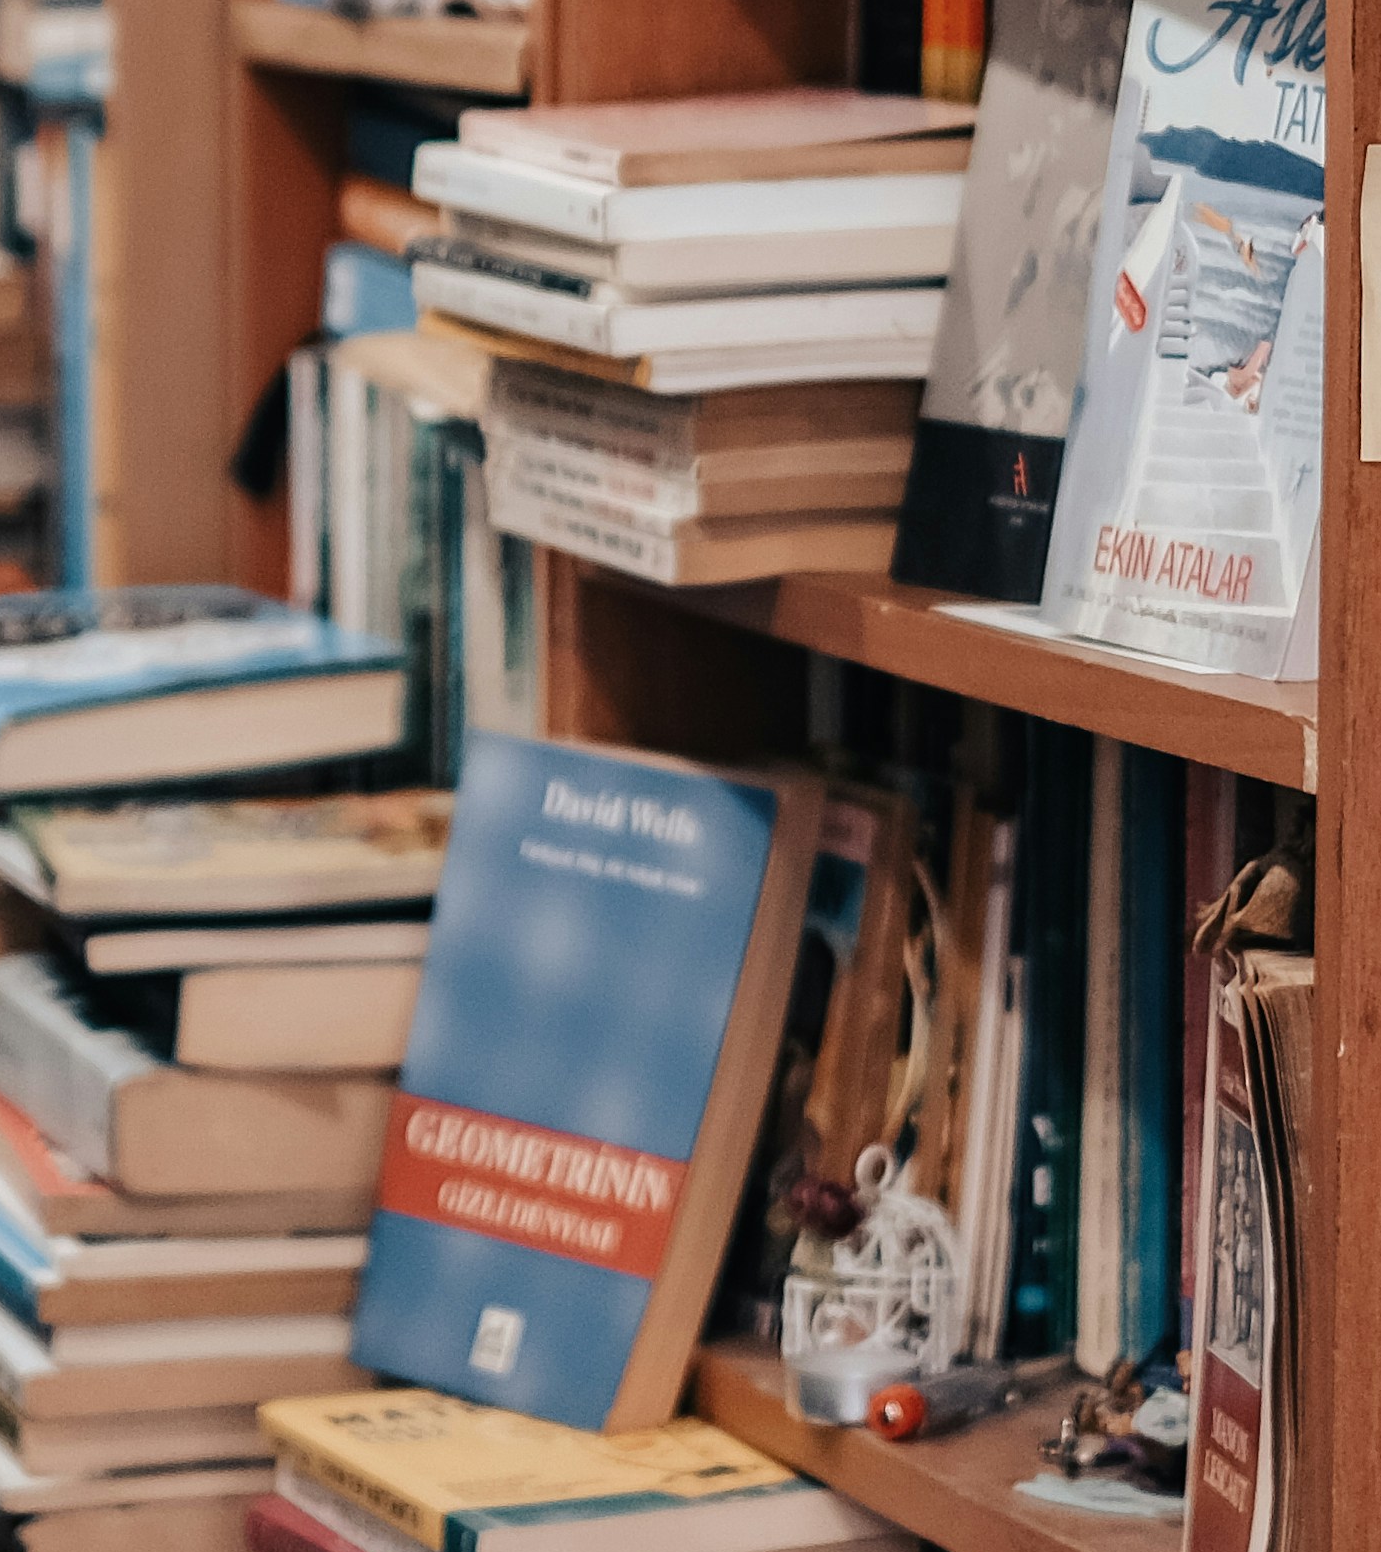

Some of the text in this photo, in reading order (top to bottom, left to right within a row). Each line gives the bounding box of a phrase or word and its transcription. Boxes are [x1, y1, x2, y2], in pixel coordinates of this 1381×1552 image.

[1093, 521, 1254, 605] EKİN ATALAR
[542, 780, 620, 833] David
